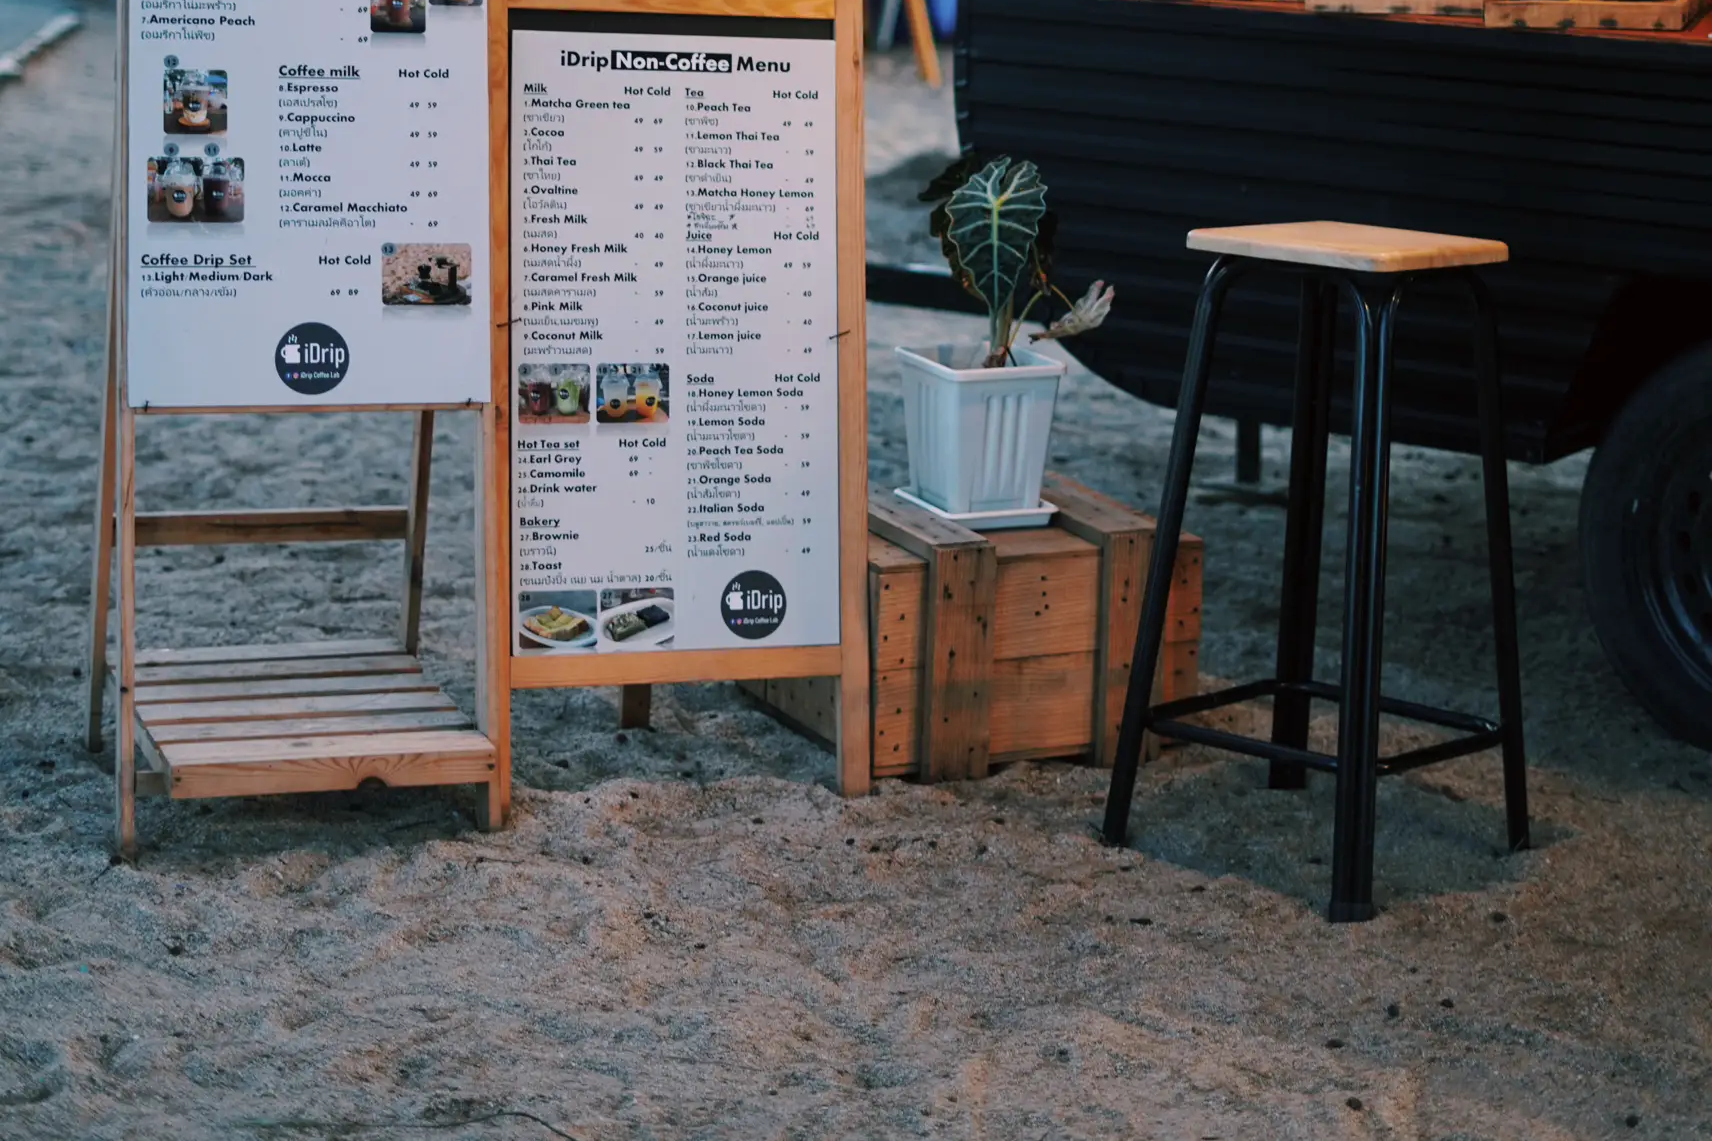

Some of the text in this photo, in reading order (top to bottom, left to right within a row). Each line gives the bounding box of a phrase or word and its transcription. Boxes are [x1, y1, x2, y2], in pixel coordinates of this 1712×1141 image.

[220, 16, 255, 26] Peach
[561, 50, 790, 72] iDrip Non-Coffee Menu
[279, 65, 360, 77] Coffee milk
[399, 69, 449, 79] Hot Cold
[524, 84, 547, 93] Milk
[625, 87, 671, 96] Hot Cold
[685, 88, 704, 97] Tea
[773, 90, 818, 99] Hot Cold
[576, 100, 609, 109] Green
[613, 101, 630, 109] tea
[732, 104, 751, 112] Tea
[736, 132, 758, 141] Thai
[761, 132, 779, 141] Tea
[557, 157, 576, 166] Tea
[730, 160, 751, 169] Thai
[755, 160, 774, 169] Tea
[741, 188, 775, 199] Honey
[779, 189, 814, 198] Lemon
[347, 203, 407, 212] Macchiato
[564, 215, 587, 224] Milk
[686, 231, 712, 240] Juice
[774, 231, 819, 240] Hot Cold
[572, 244, 600, 253] Fresh
[604, 244, 627, 253] Milk
[737, 245, 772, 254] Lemon
[141, 253, 252, 267] Coffee Drip Set
[319, 255, 371, 266] Hot Cold
[581, 273, 610, 282] Fresh
[614, 273, 637, 282] Milk
[742, 274, 766, 285] juice
[559, 302, 583, 311] Milk
[744, 303, 768, 313] juice
[579, 331, 603, 340] Milk
[737, 331, 761, 342] juice
[305, 343, 345, 368] iDrip
[687, 374, 714, 383] Soda
[775, 373, 820, 382] Hot Cold
[738, 389, 773, 397] Lemon
[776, 387, 803, 397] Soda
[738, 417, 765, 426] Soda
[518, 440, 580, 449] Hot Tea set
[619, 438, 666, 447] Hot Cold
[735, 446, 753, 454] Tea
[757, 445, 784, 454] Soda
[554, 455, 581, 465] Grey
[744, 475, 771, 484] Soda
[564, 485, 597, 493] water
[737, 504, 764, 512] Soda
[520, 517, 560, 528] Bakery
[724, 533, 751, 542] Soda
[747, 589, 782, 614] iDrip
